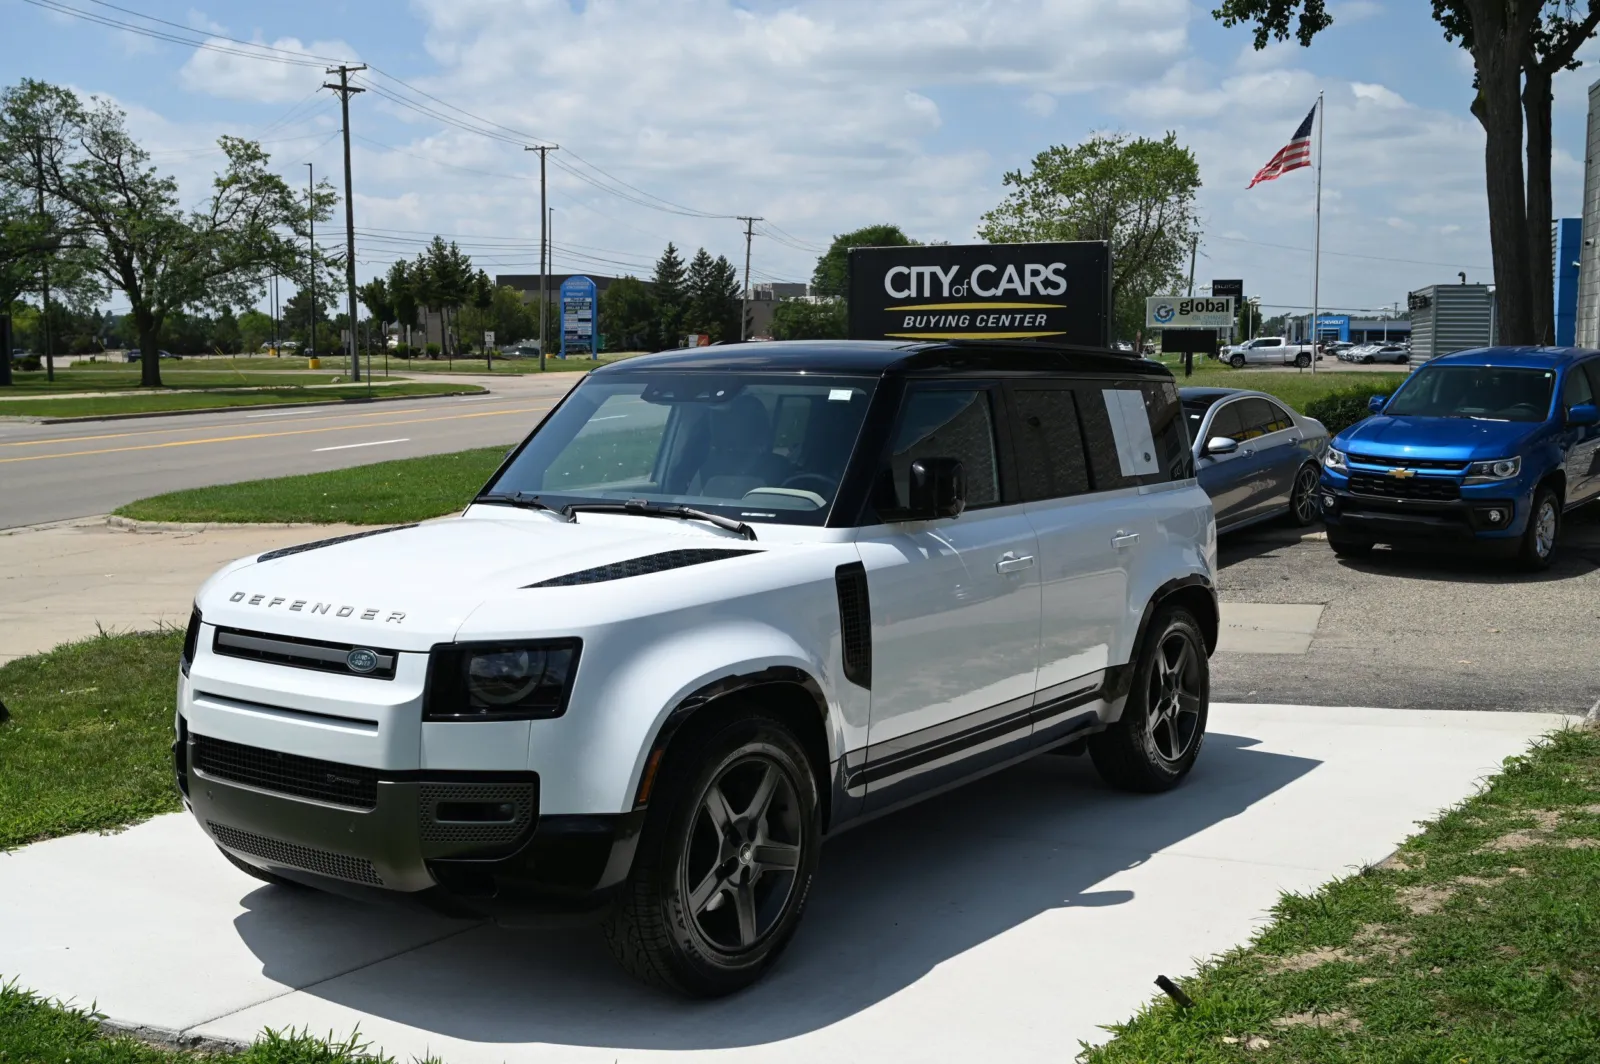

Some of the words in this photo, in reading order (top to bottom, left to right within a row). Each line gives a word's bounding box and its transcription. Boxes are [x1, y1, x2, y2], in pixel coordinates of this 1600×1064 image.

[884, 265, 960, 299] CITY
[952, 279, 969, 297] of
[970, 262, 1068, 297] CARS
[1179, 298, 1230, 315] global
[902, 314, 970, 328] BUYING
[975, 313, 1048, 327] CENTER
[229, 591, 406, 624] DEFENDER
